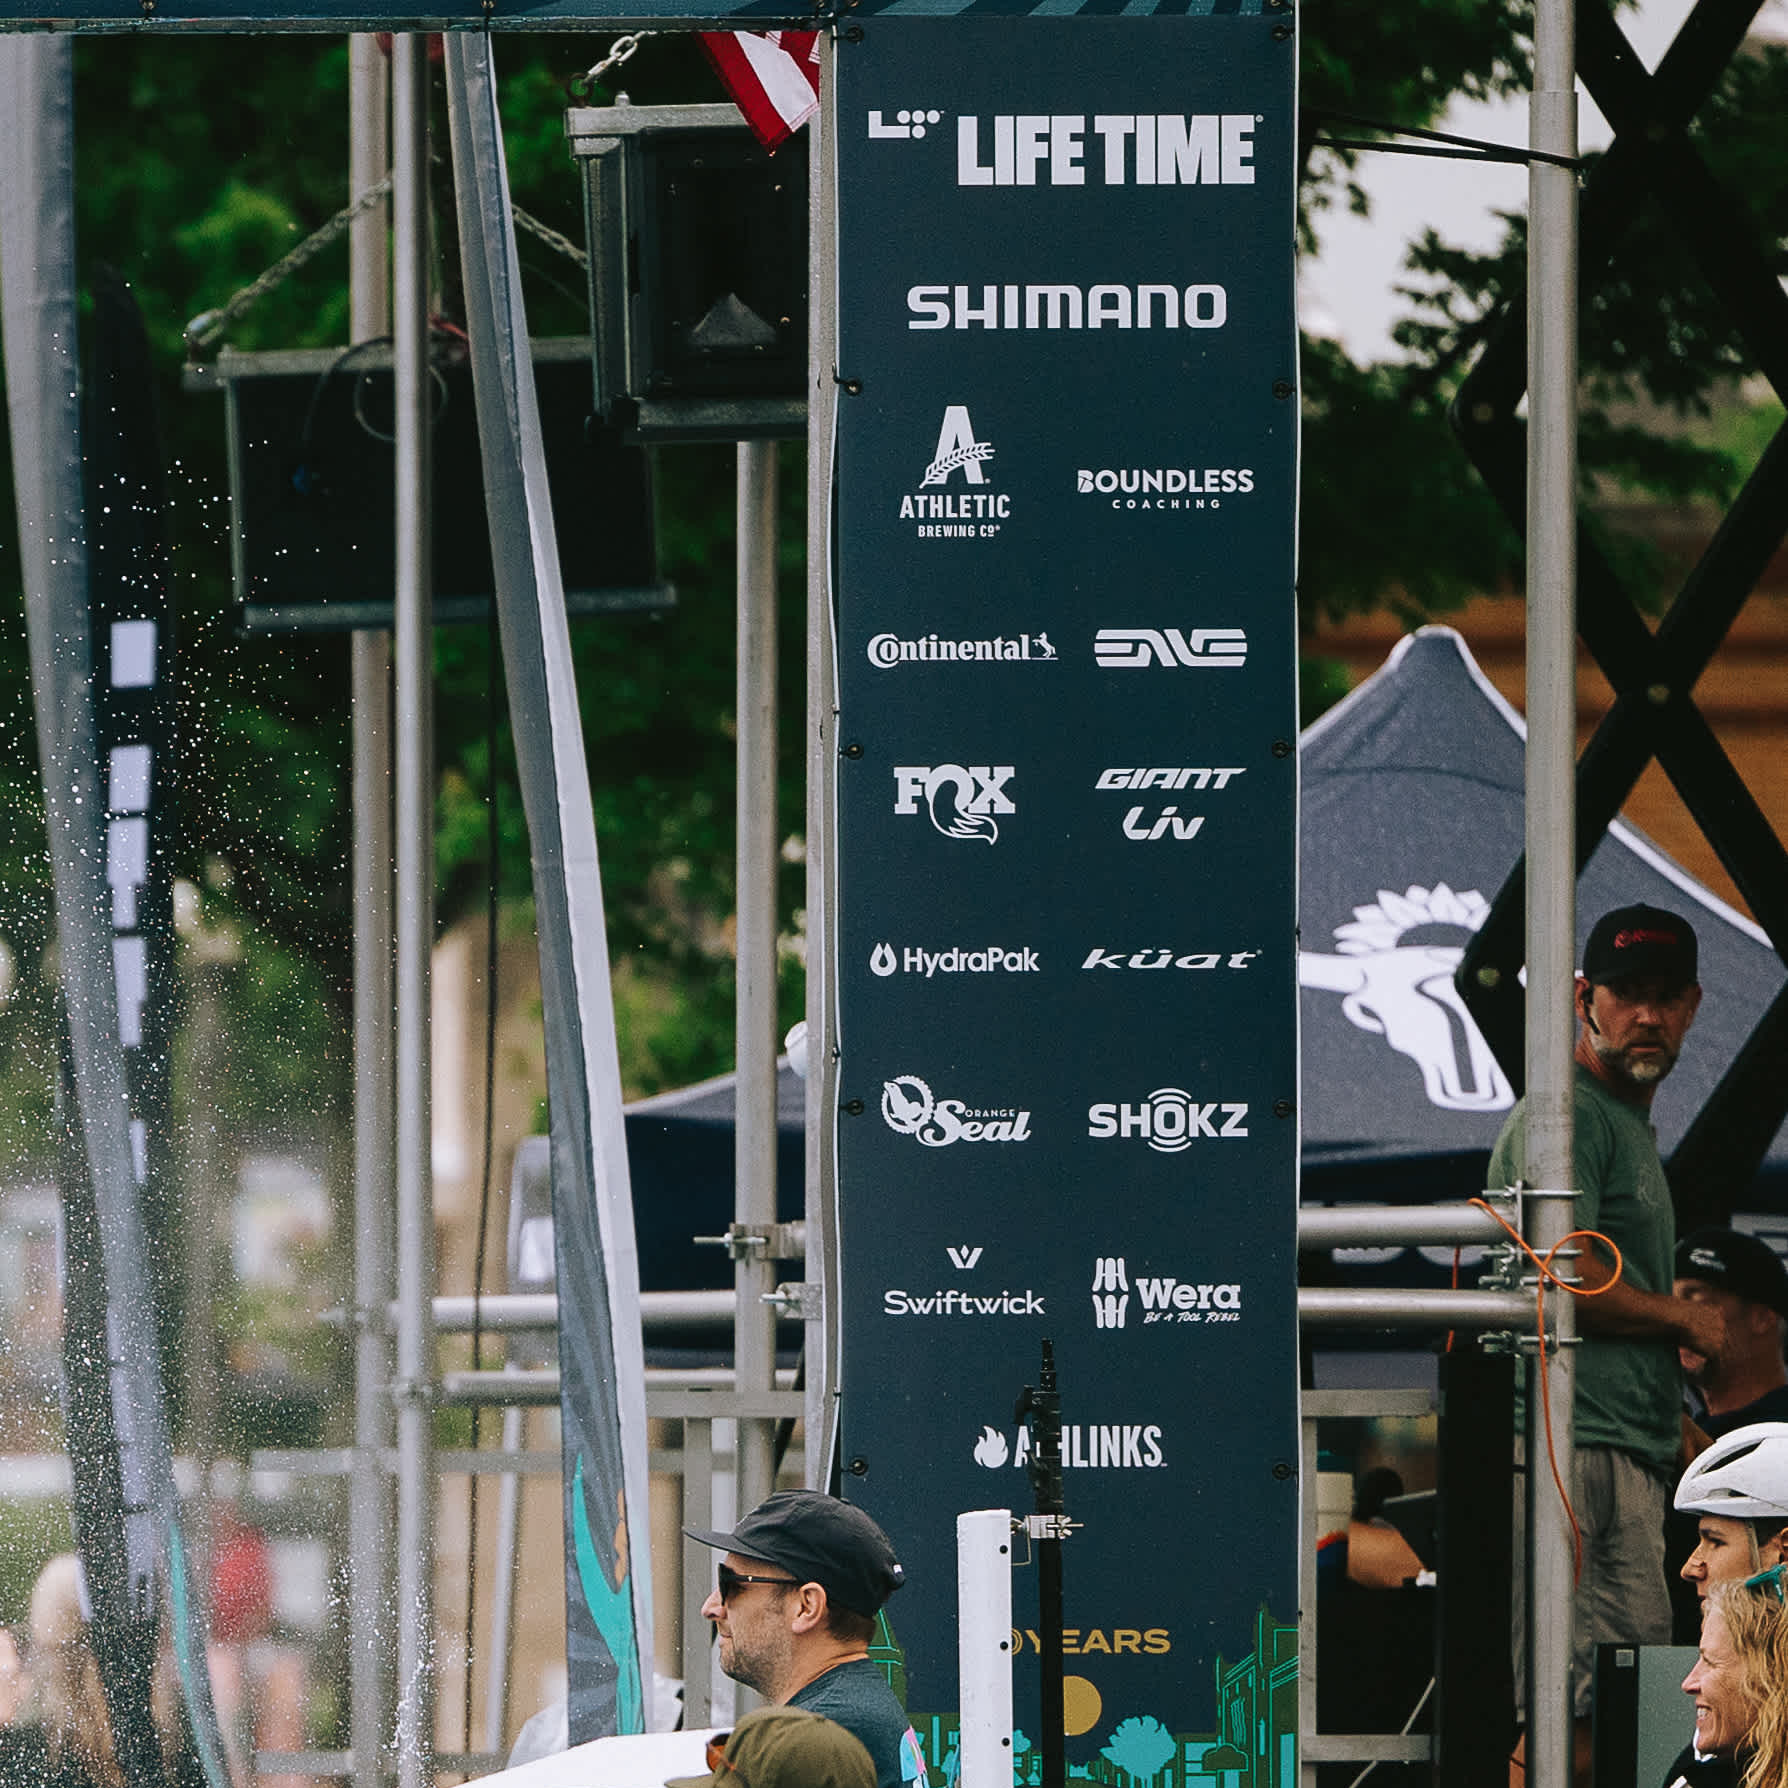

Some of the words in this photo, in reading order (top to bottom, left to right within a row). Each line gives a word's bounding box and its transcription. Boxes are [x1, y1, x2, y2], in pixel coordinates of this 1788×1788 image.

[957, 115, 1086, 186] LIFE
[1094, 114, 1256, 185] TIME
[906, 284, 1227, 330] SHIMANO
[1077, 469, 1254, 494] BOUNDLESS
[899, 494, 1011, 519] ATHLETIC
[1112, 499, 1220, 510] COACHING
[917, 524, 976, 539] BREWING
[867, 633, 1030, 669] Continental
[1095, 767, 1247, 790] GIANT
[893, 764, 1016, 832] FOX
[1122, 806, 1205, 841] Liv
[903, 946, 1041, 978] HydraPak
[1081, 948, 1256, 970] küat
[915, 1099, 1032, 1147] Seal
[964, 1108, 1016, 1118] ORANGE
[1088, 1100, 1249, 1142] SHOKZ
[883, 1289, 1046, 1316] Swiftwick
[1135, 1277, 1241, 1310] Wera
[1013, 1424, 1162, 1468] AHLINKS
[1024, 1628, 1172, 1655] YEARS
